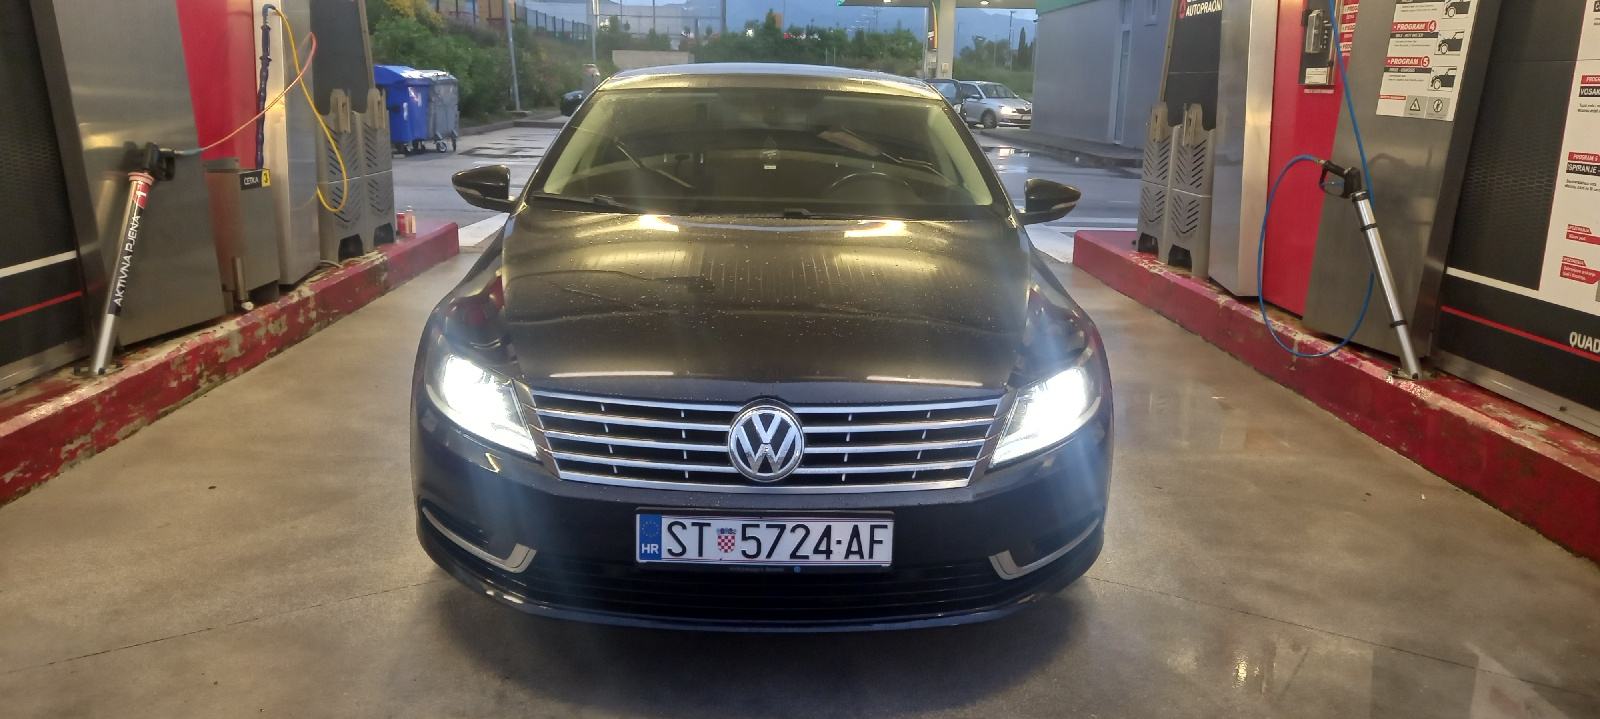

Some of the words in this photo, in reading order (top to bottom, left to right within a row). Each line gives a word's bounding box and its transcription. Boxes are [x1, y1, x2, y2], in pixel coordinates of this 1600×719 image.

[1429, 21, 1435, 30] 4
[1422, 57, 1428, 67] 5
[113, 254, 132, 306] AKTIVNA
[125, 215, 141, 252] PJENA
[1569, 331, 1600, 354] QUAD
[730, 408, 803, 479] VW
[641, 543, 659, 555] HR
[667, 521, 712, 558] ST
